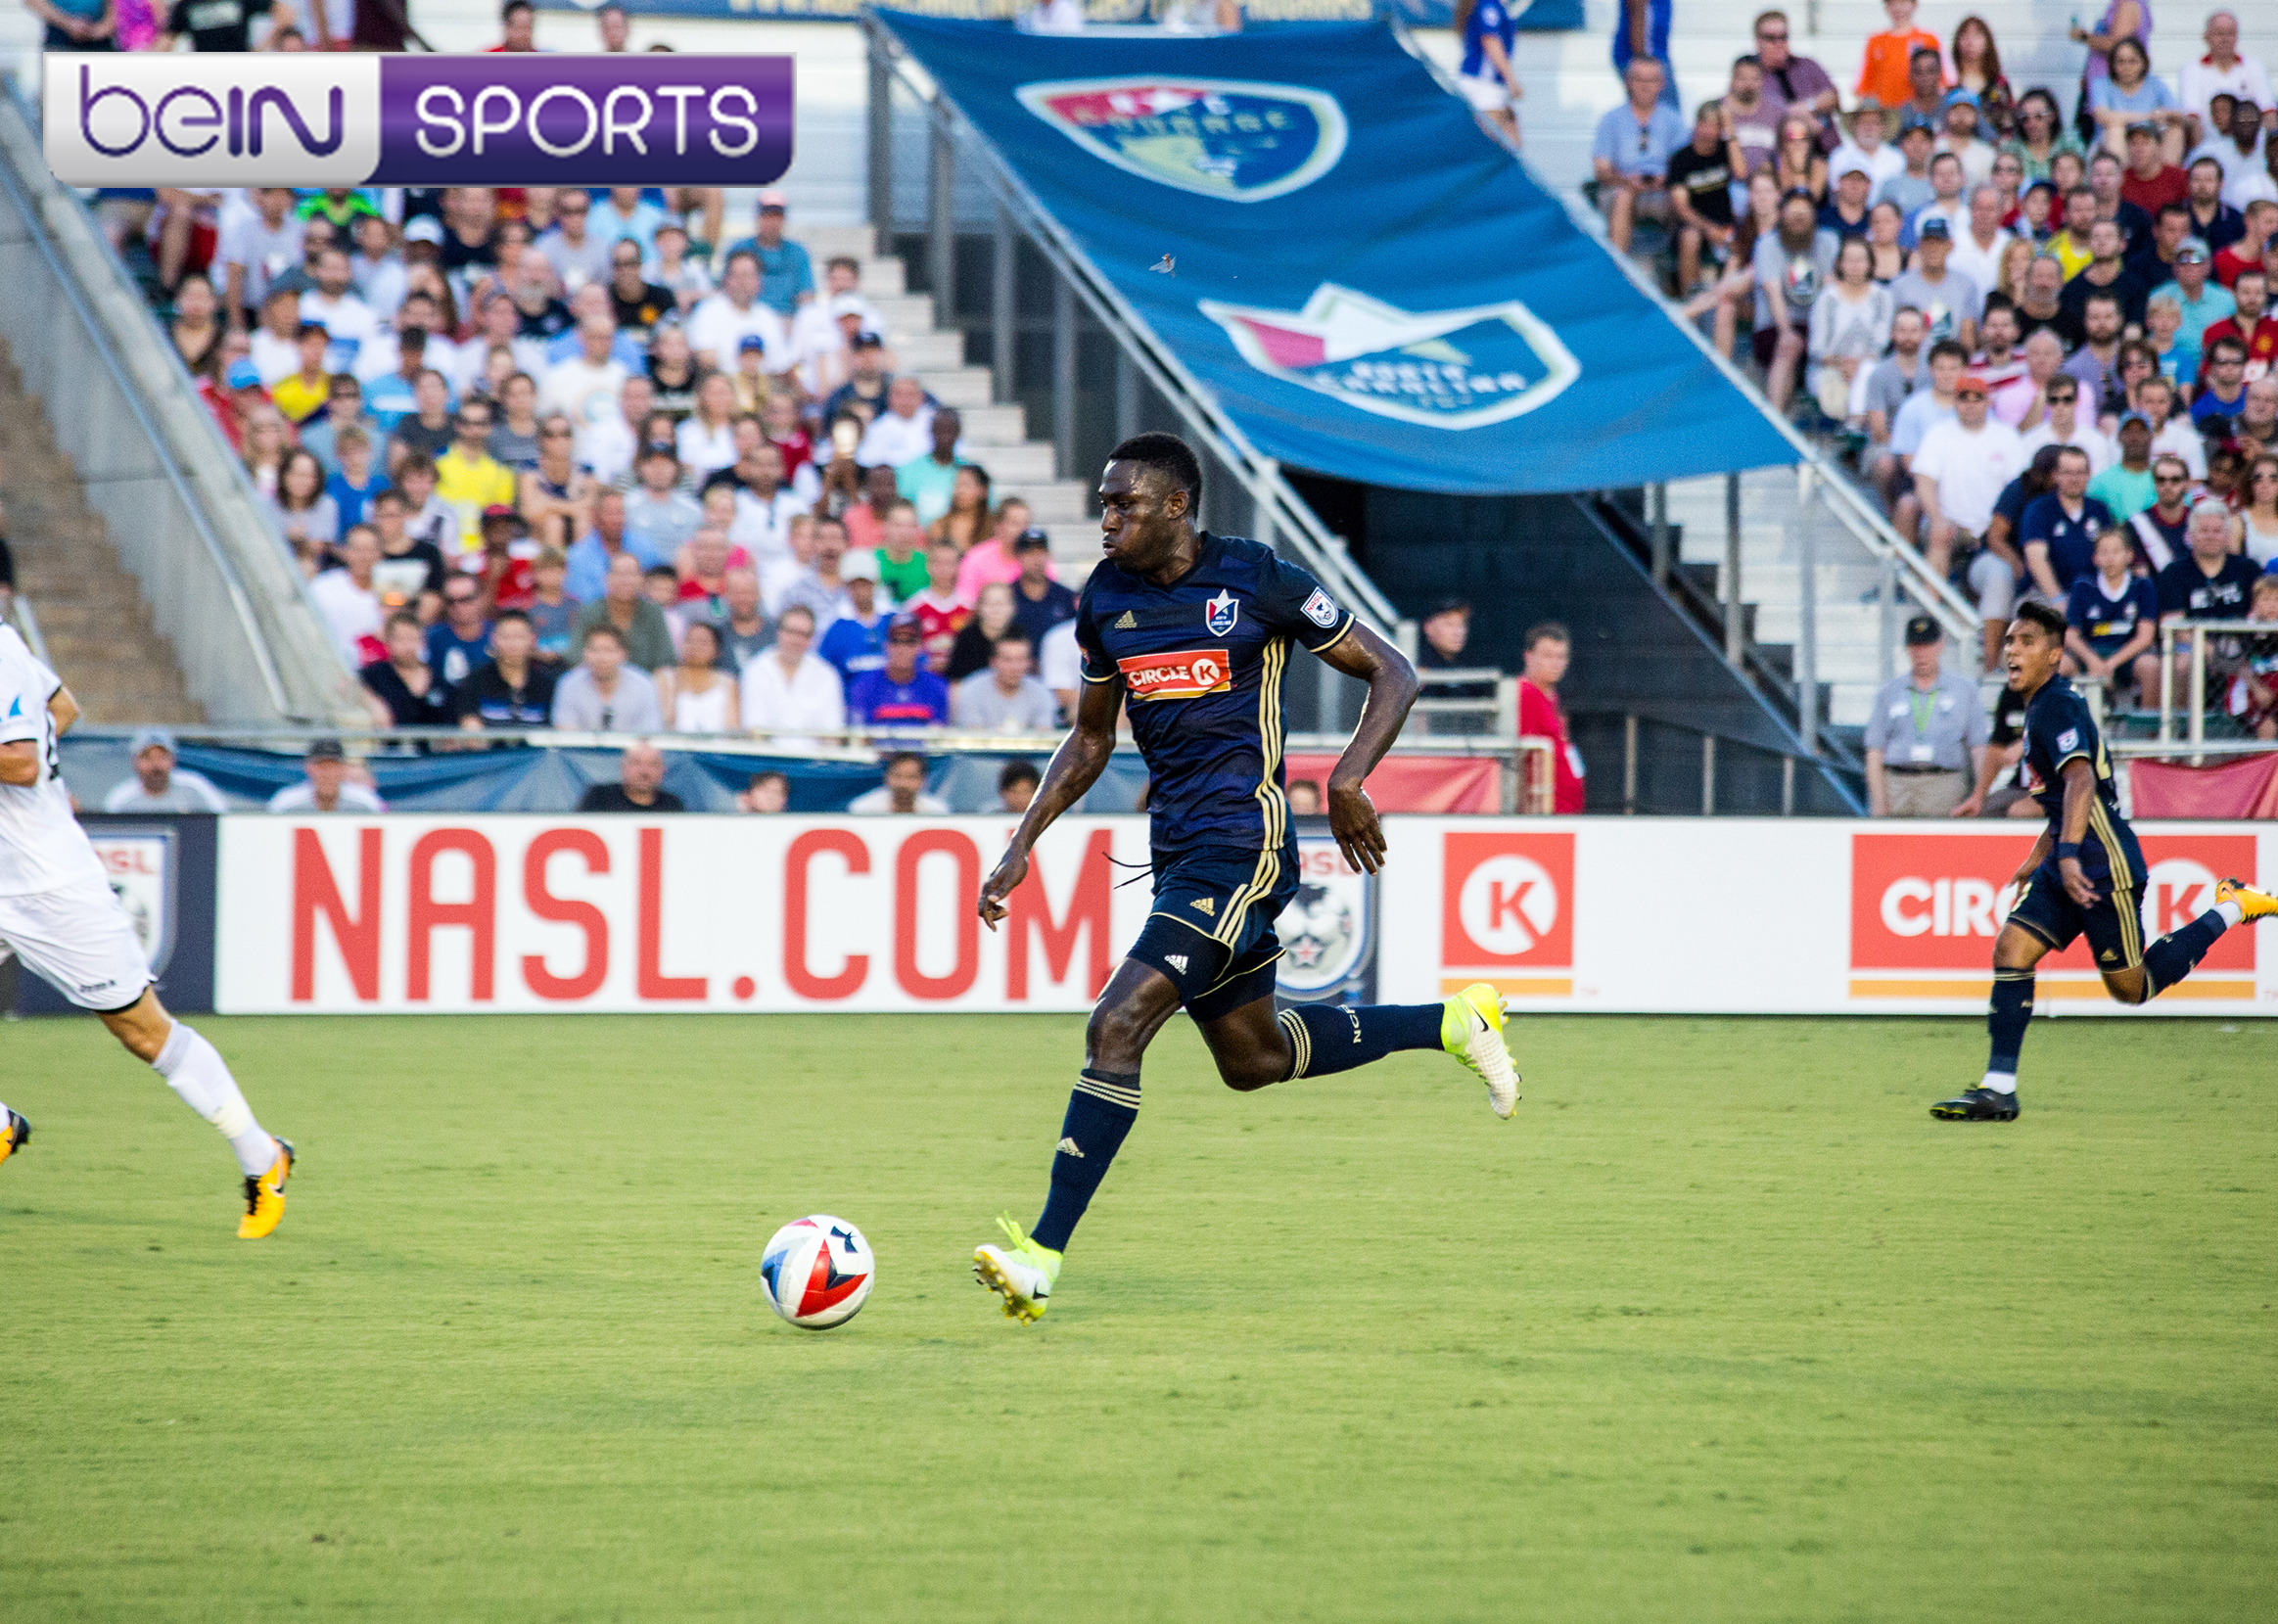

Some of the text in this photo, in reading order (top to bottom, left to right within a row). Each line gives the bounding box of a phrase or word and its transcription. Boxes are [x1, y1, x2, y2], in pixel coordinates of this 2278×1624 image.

[1306, 594, 1324, 613] NASL
[1128, 666, 1190, 687] CIRCLE
[290, 827, 1114, 1001] NASL.COM
